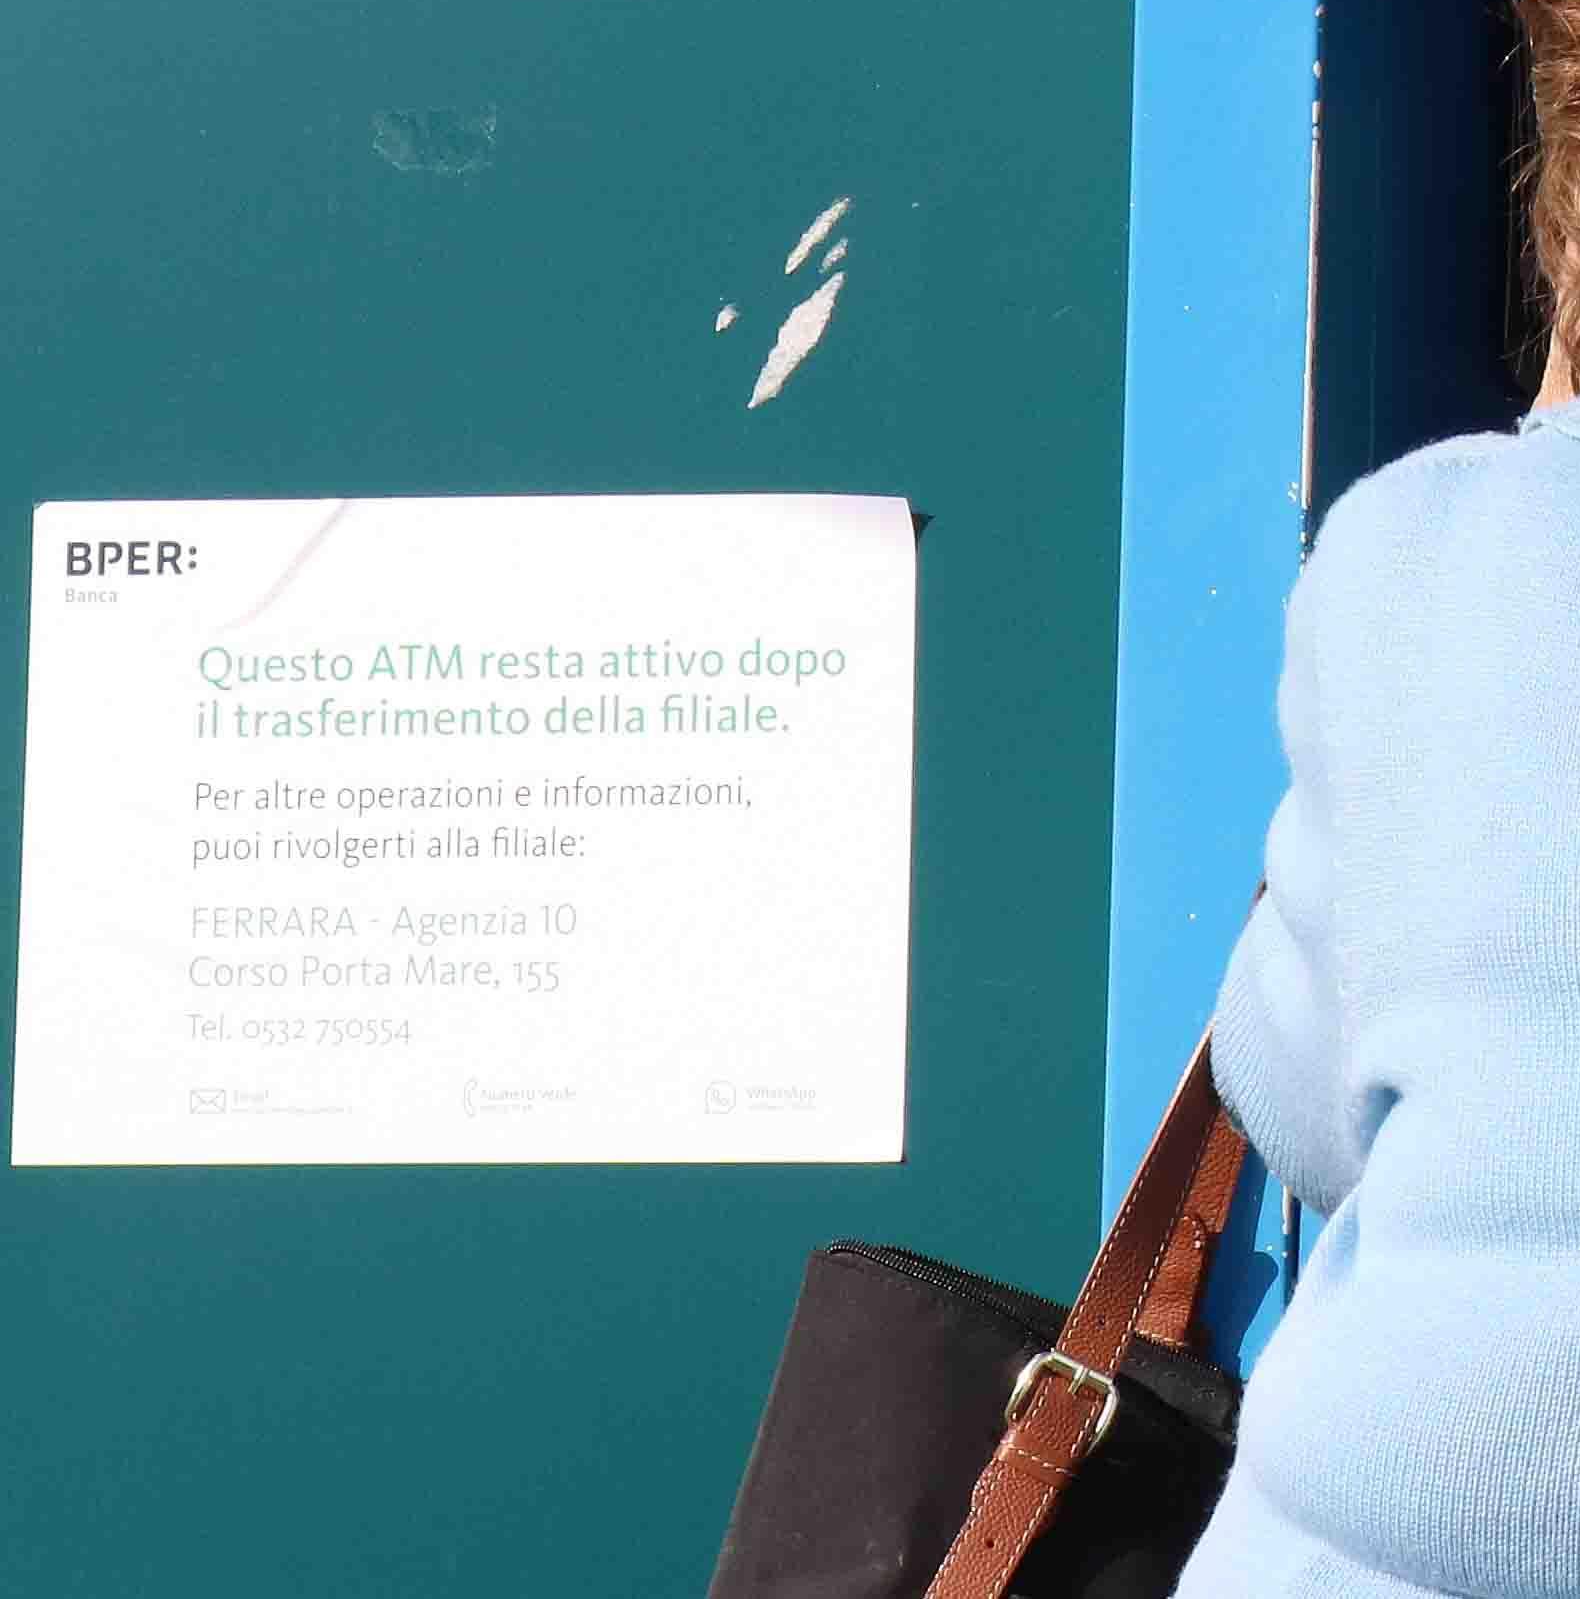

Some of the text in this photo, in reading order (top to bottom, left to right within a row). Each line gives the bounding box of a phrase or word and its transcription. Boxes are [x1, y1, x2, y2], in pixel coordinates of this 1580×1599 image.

[65, 588, 118, 602] Banca
[199, 637, 845, 690] Questo ATM resta attivo dopo
[198, 694, 789, 738] il trasferimento della filiale.
[196, 776, 751, 818] Per altre operazioni e informazioni,
[193, 826, 584, 869] puoi rivolgerti alla filiale:
[192, 906, 357, 938] FERRARA
[392, 906, 527, 945] Agenzia
[541, 903, 576, 935] 10
[189, 954, 560, 993] Corso Porta Mare, 155
[184, 1010, 412, 1046] Tel. 0532 750554
